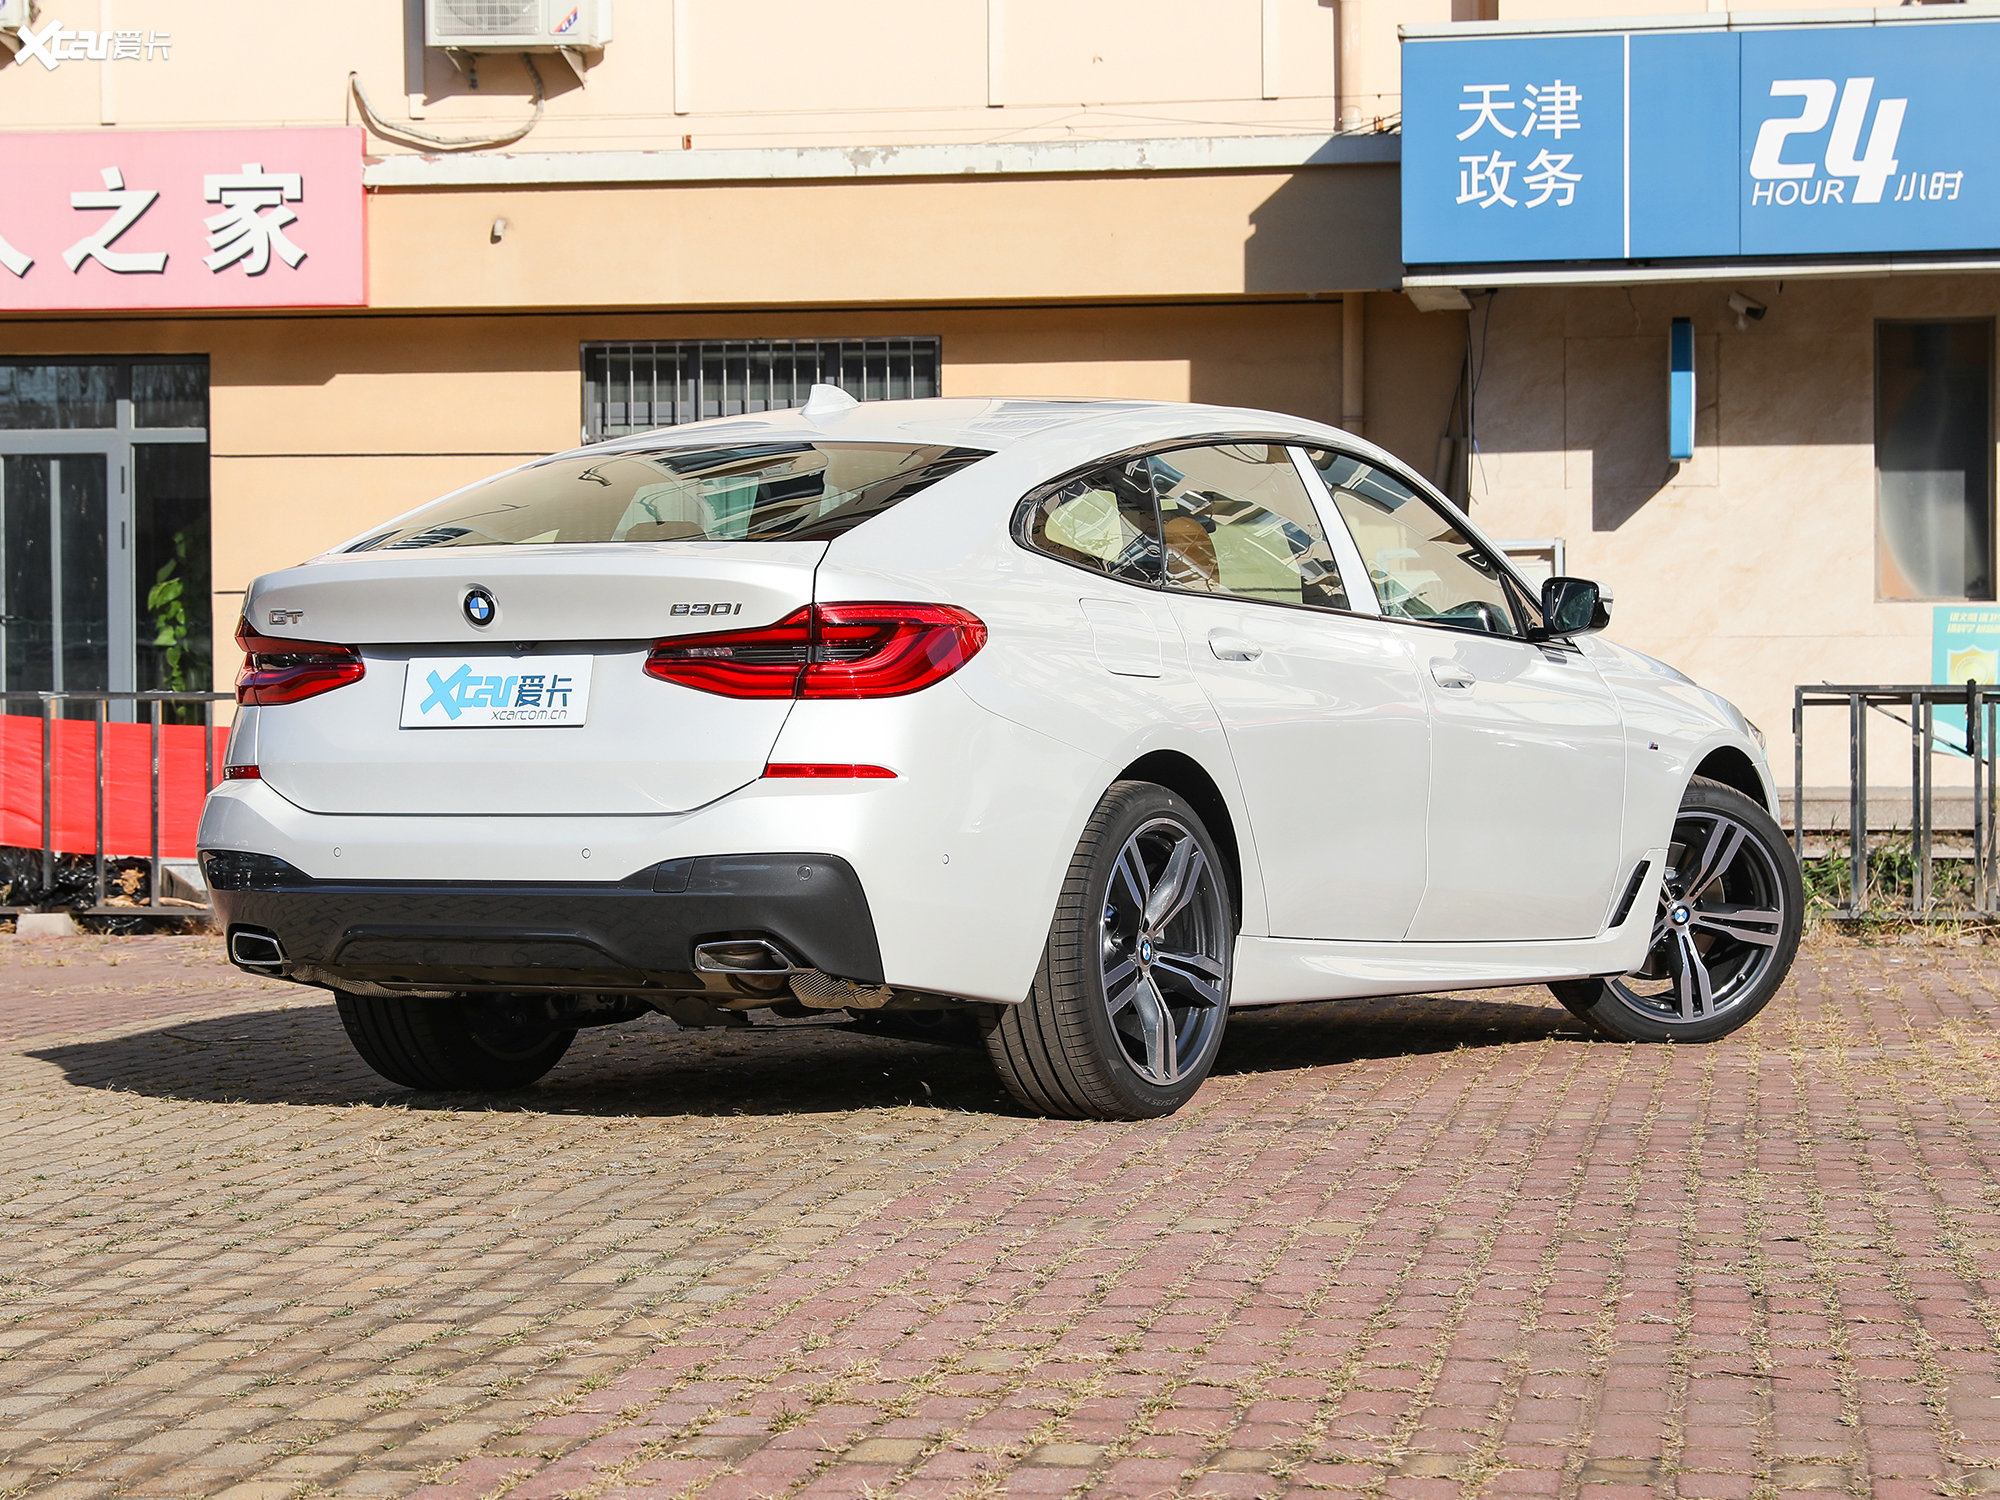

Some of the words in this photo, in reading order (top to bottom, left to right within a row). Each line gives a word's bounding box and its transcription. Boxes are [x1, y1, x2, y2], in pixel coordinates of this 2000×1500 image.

[1455, 79, 1583, 141] 天津
[1749, 76, 1908, 204] 24
[1455, 148, 1584, 209] 政务
[1752, 179, 1845, 206] HOUR
[1894, 170, 1965, 201] 小时
[0, 163, 308, 278] 之家
[269, 608, 304, 625] GT
